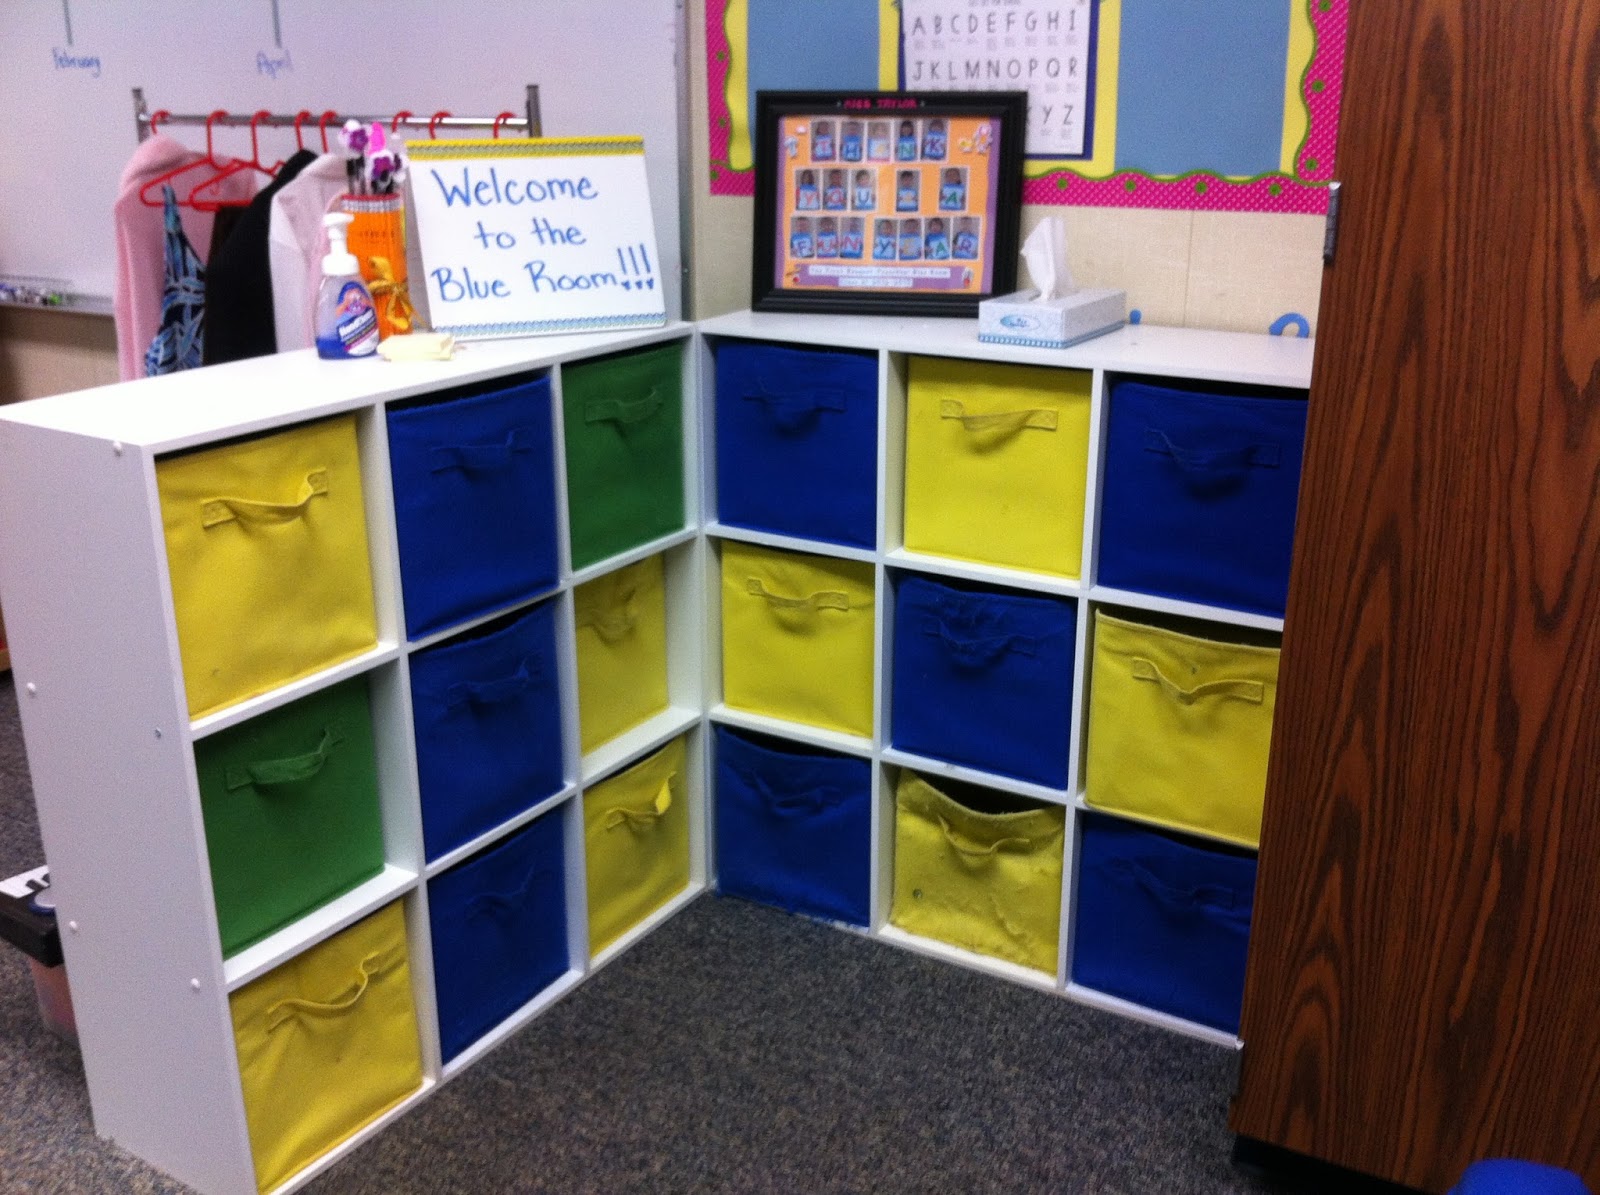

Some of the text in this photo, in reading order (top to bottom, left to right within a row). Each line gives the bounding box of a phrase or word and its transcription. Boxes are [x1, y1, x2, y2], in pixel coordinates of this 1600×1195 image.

[912, 16, 926, 36] A
[934, 15, 943, 35] B
[951, 14, 961, 35] C
[968, 14, 979, 33] D
[986, 12, 997, 33] E
[1006, 12, 1016, 32] F
[1025, 11, 1038, 32] G
[1047, 10, 1060, 31] H
[912, 56, 1078, 81] J K L M N O P Q R
[1042, 105, 1053, 125] Y
[1063, 104, 1074, 125] Z
[430, 165, 600, 208] Welcome
[474, 216, 588, 250] to the
[430, 243, 655, 303] Blue Room!!!
